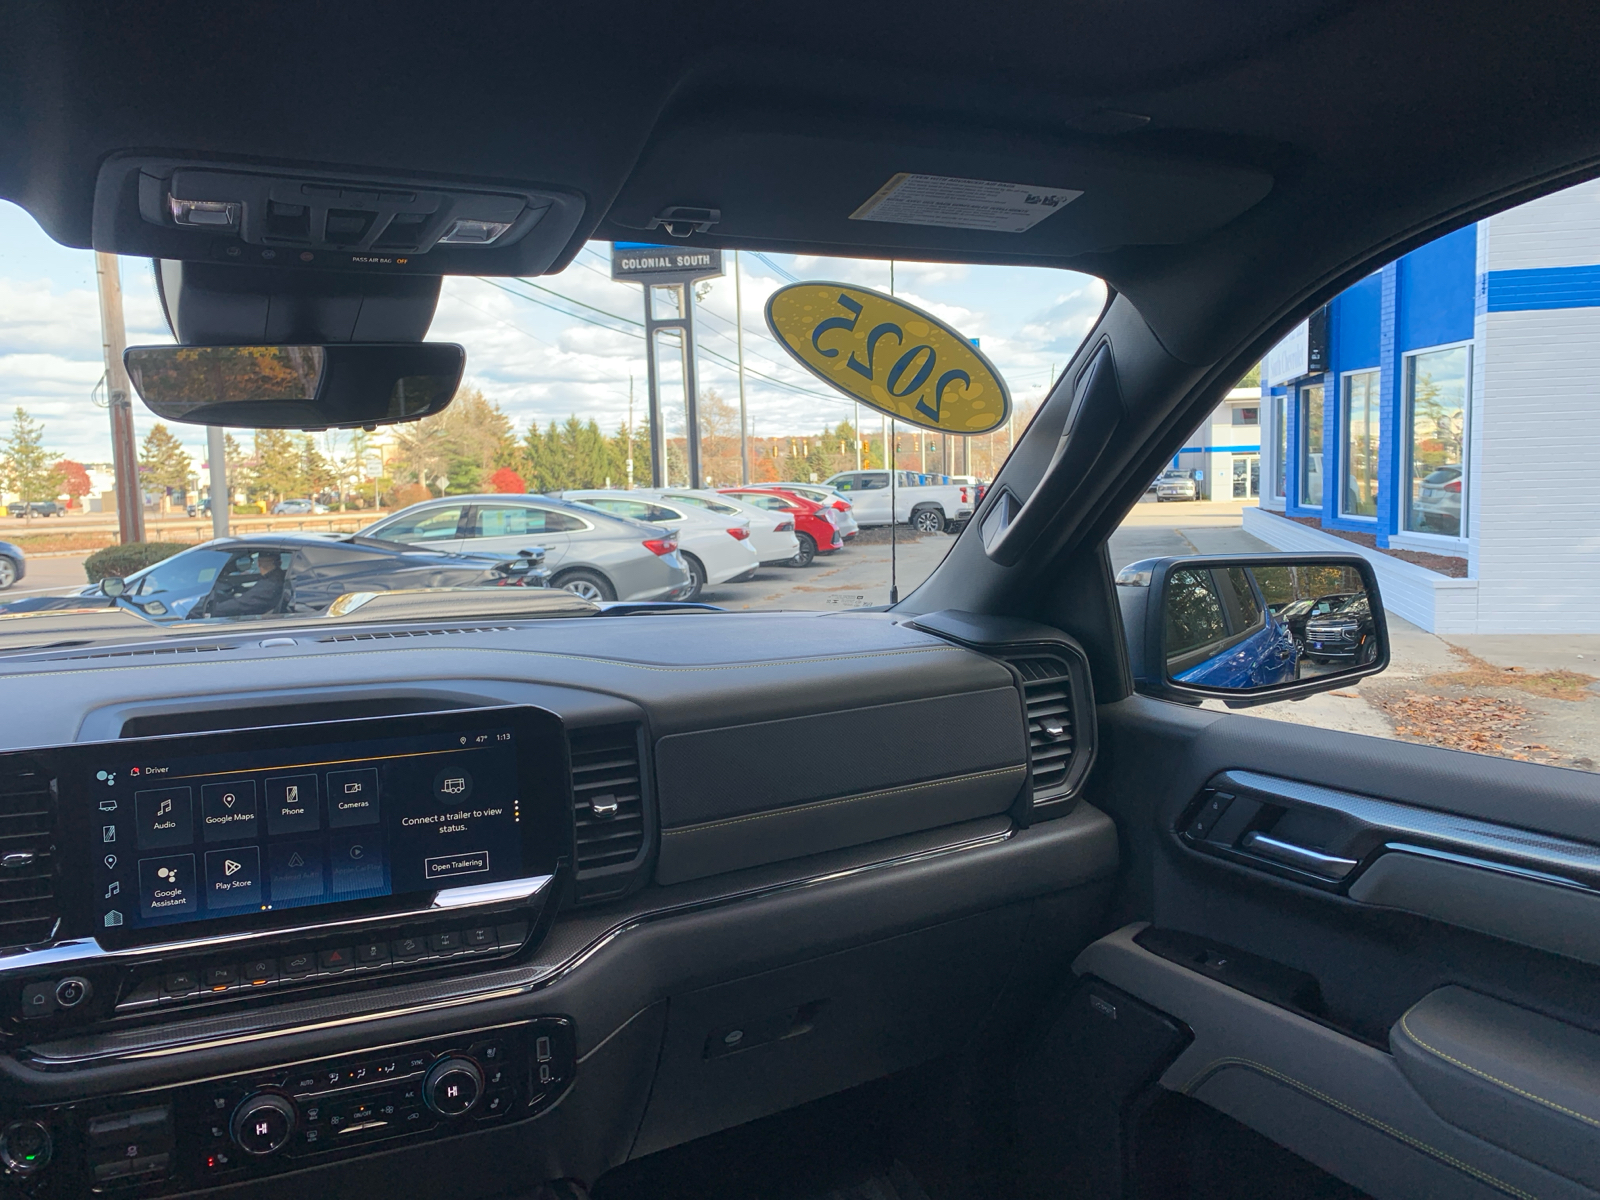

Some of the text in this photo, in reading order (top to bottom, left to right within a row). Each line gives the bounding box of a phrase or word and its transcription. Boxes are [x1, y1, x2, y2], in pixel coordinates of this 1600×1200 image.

[622, 254, 710, 270] COLONIAL SOUTH
[145, 766, 169, 775] Driver
[338, 800, 369, 810] Cameras
[282, 806, 305, 816] Phone
[206, 812, 255, 825] Google Maps
[402, 814, 438, 826] Connect
[446, 811, 472, 821] trailer
[473, 810, 482, 818] to
[482, 808, 503, 817] view
[153, 820, 176, 830] Audio
[439, 824, 468, 834] status.
[432, 858, 483, 872] Open Trailering
[302, 870, 320, 878] Auto
[216, 878, 252, 891] Play Store
[154, 888, 182, 899] Google
[151, 898, 187, 908] Assistant
[410, 1059, 424, 1067] SYNC
[300, 1079, 314, 1087] AUTO
[447, 1085, 458, 1098] HI
[354, 1110, 372, 1119] ON/OFF
[256, 1122, 268, 1136] HI
